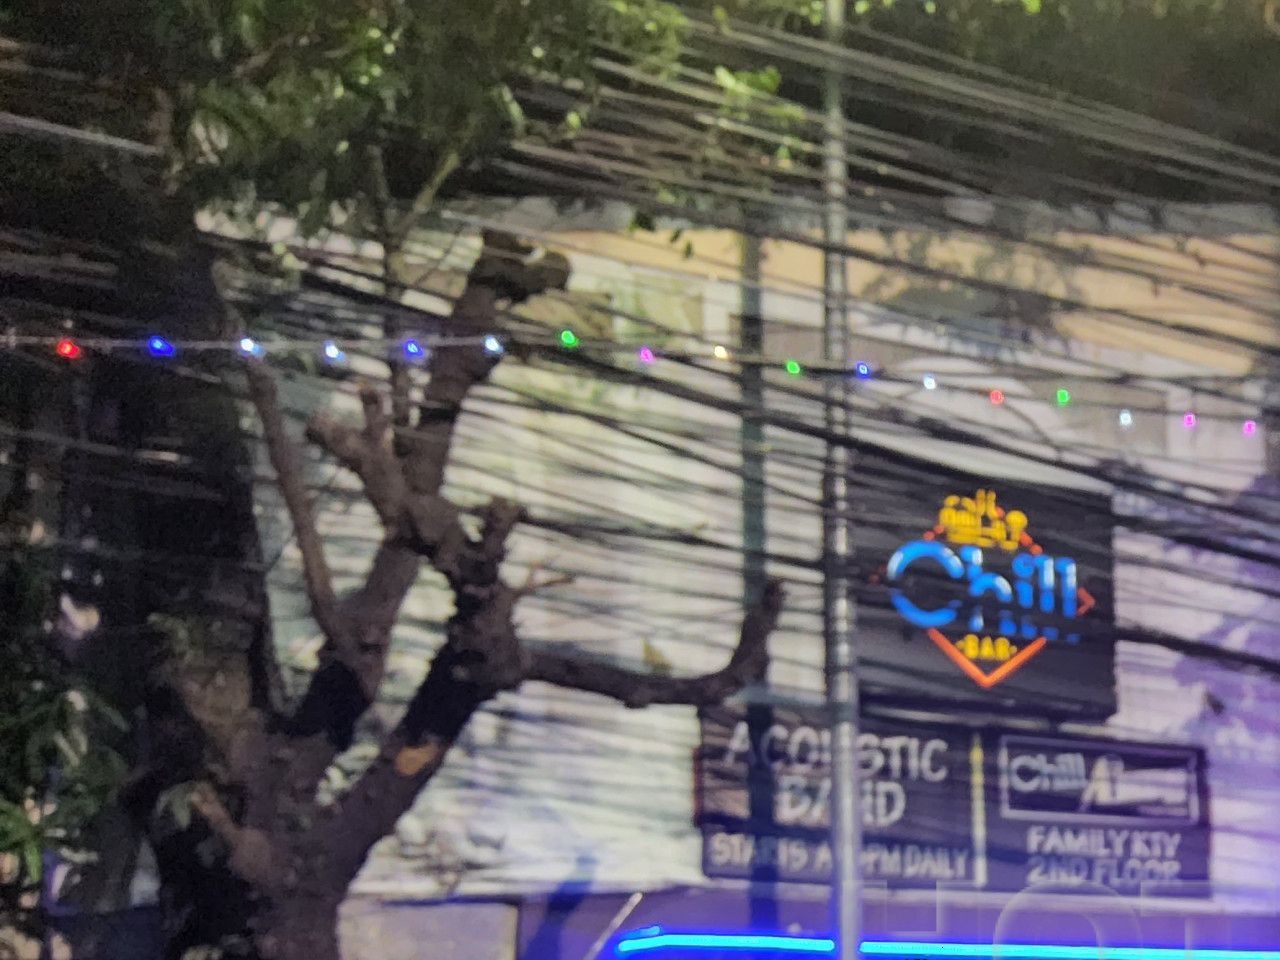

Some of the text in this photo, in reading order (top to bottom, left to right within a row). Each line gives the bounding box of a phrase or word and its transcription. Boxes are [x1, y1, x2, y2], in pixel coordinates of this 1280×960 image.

[886, 540, 1082, 642] Chill
[722, 719, 949, 783] ACOSTIC
[1026, 825, 1130, 858] FAMILY
